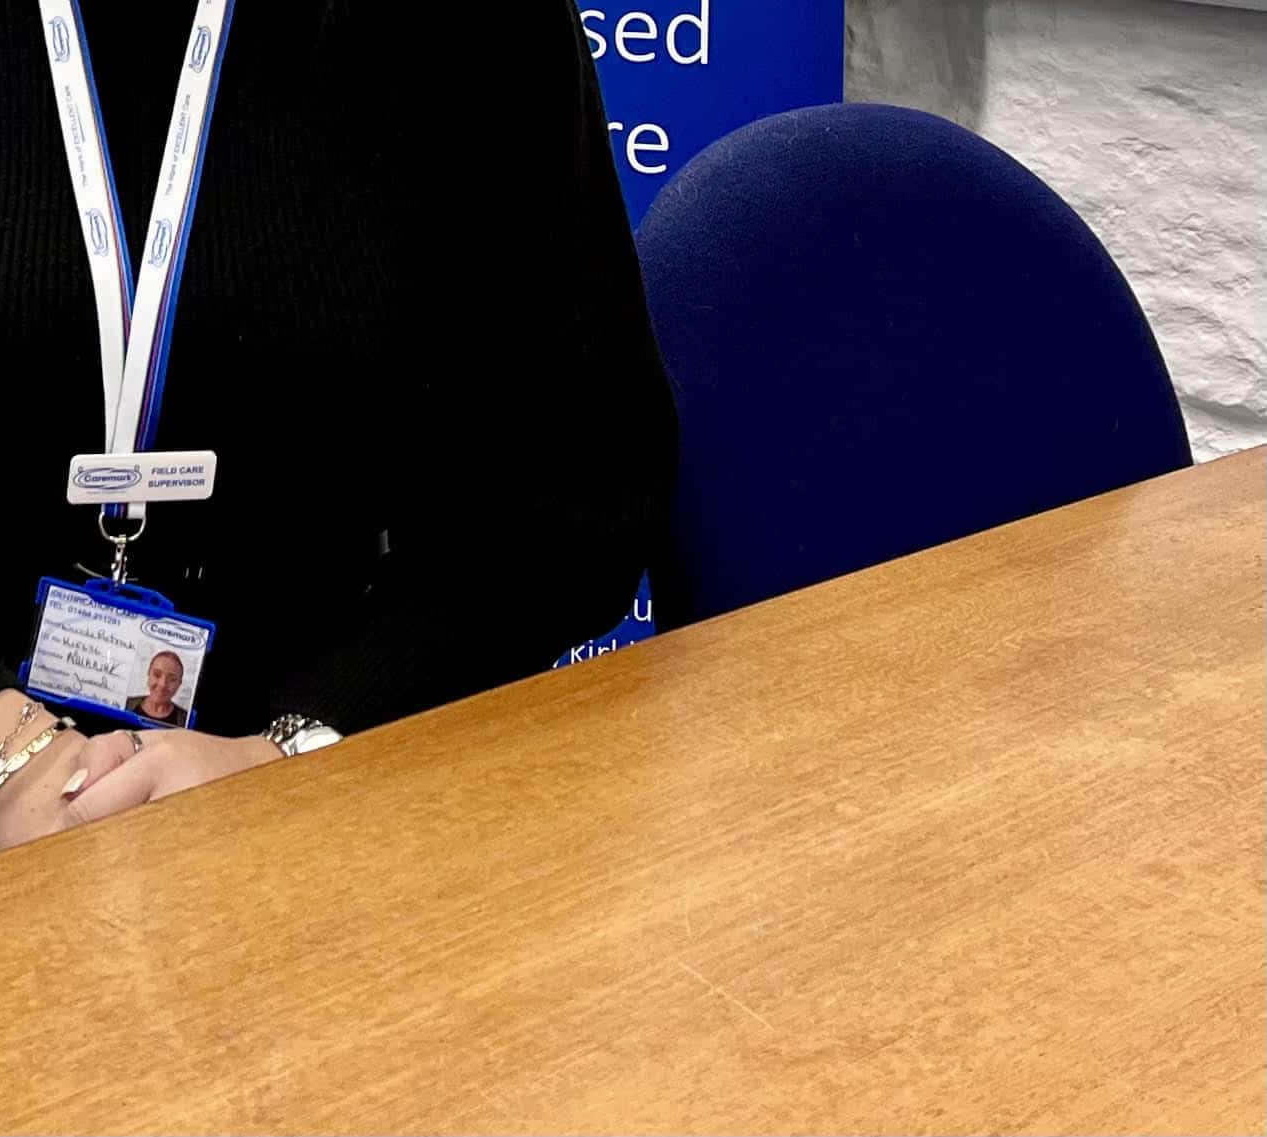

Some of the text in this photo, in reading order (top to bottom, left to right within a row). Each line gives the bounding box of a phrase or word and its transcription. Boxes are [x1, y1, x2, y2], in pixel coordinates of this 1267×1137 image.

[84, 466, 204, 483] Caremark FIELD CARE
[148, 478, 206, 488] SUPERVISOR
